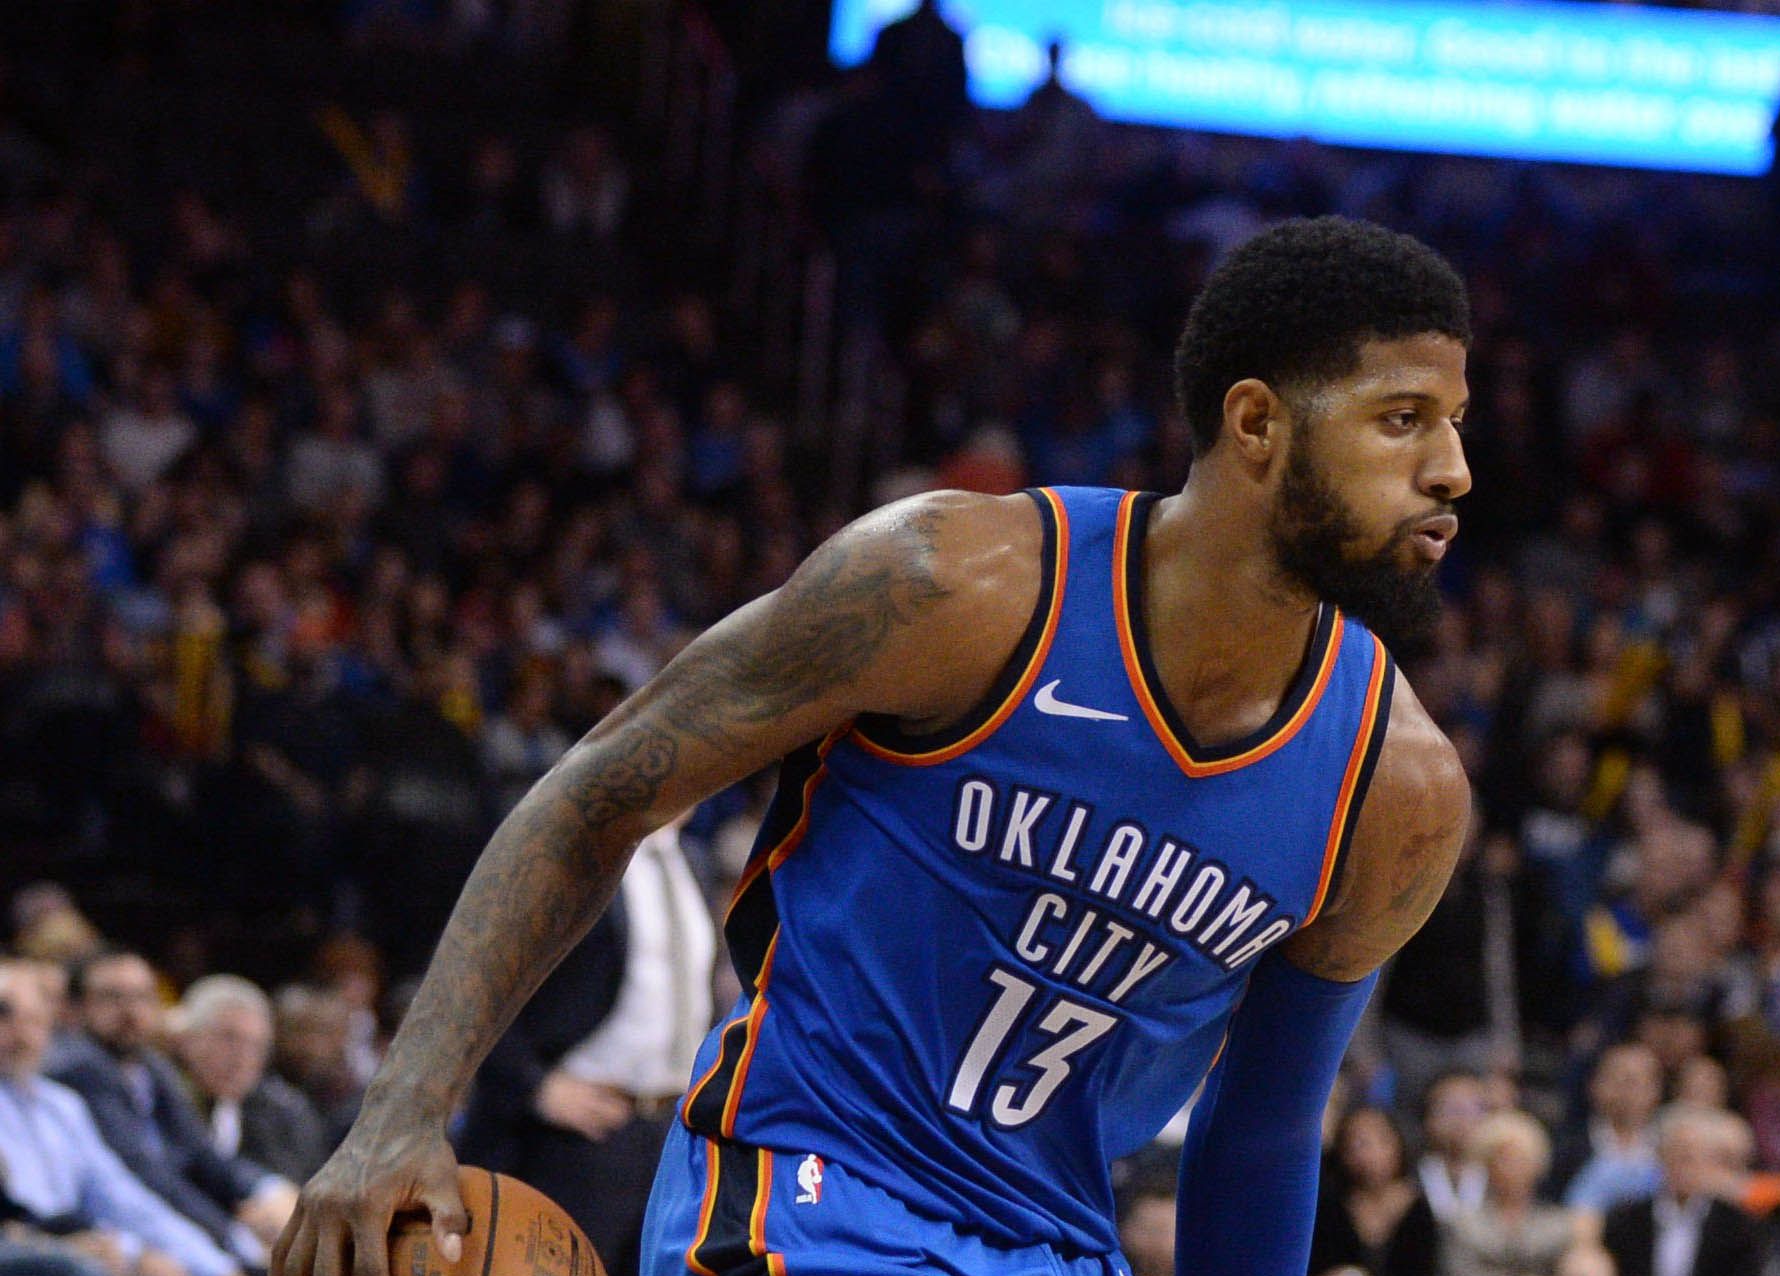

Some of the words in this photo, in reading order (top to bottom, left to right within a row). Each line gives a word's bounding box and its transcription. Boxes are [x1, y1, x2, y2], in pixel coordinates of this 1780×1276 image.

[954, 779, 1292, 970] OKLAHOMA
[1014, 892, 1170, 1004] CITY
[947, 967, 1119, 1127] 13
